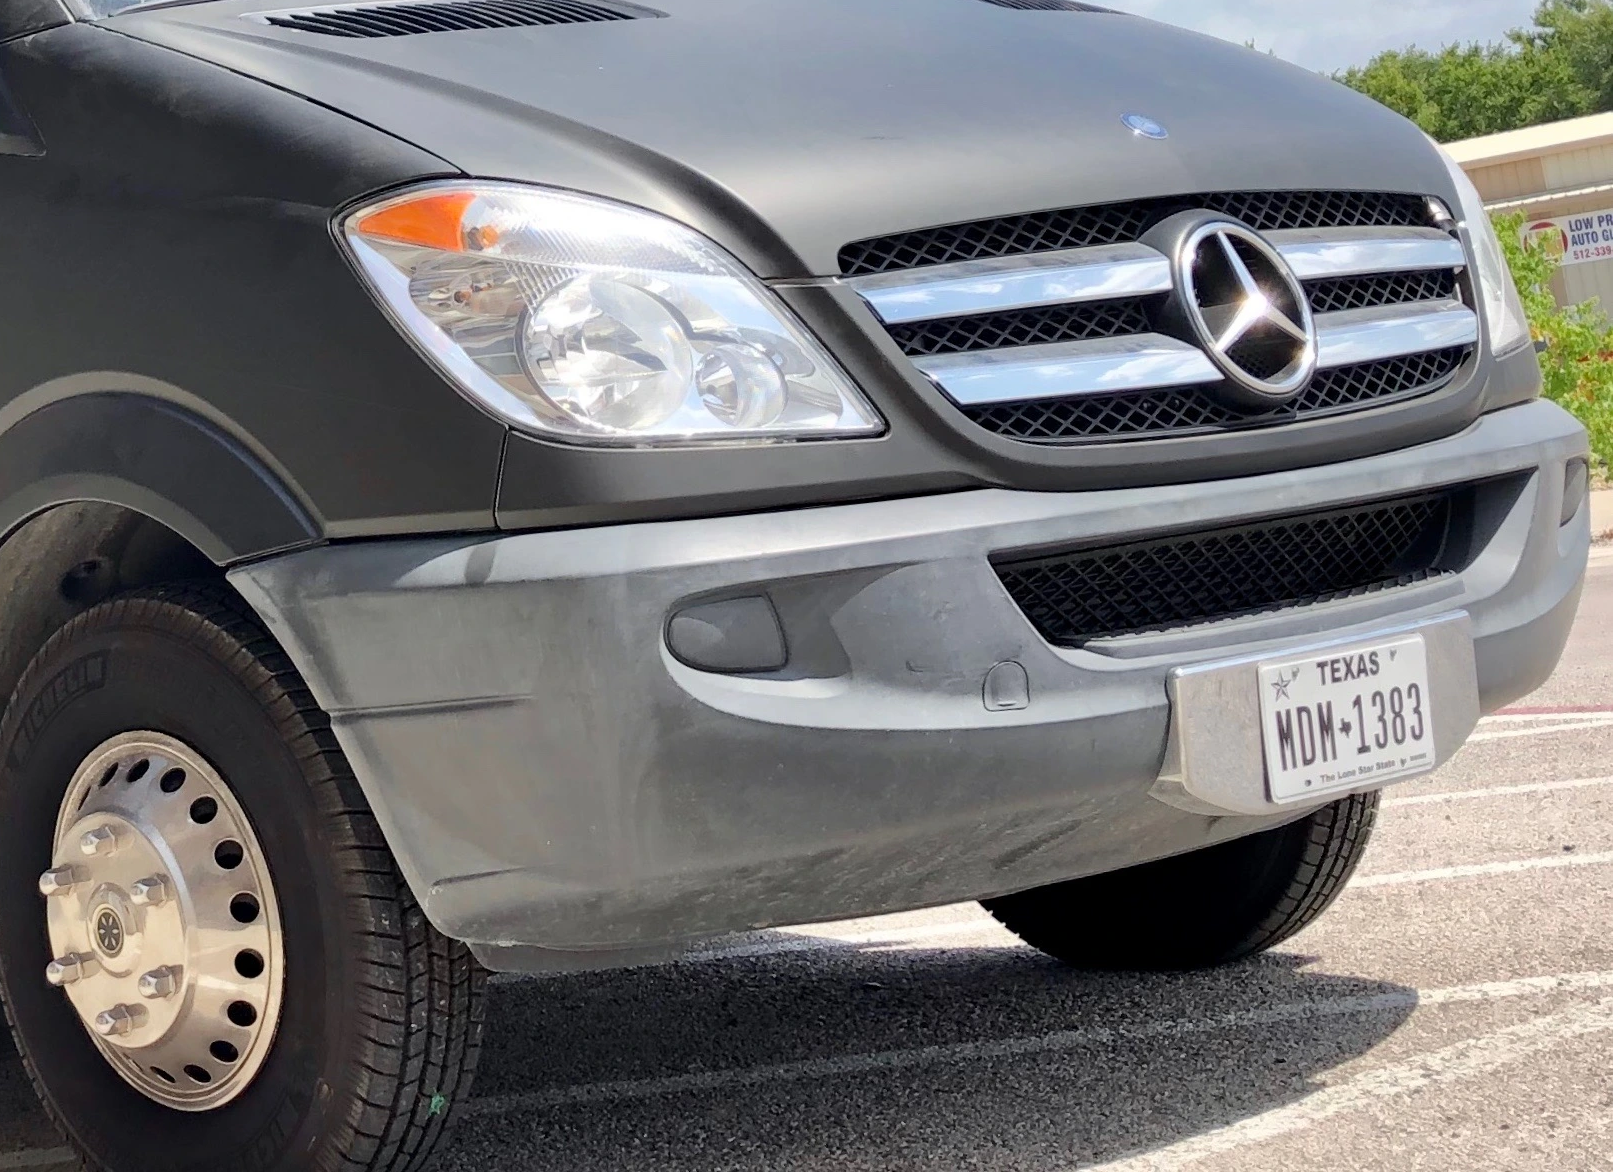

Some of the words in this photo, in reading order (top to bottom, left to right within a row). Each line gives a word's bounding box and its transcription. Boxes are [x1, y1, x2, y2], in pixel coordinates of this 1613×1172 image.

[1568, 216, 1594, 232] LOW
[1571, 231, 1599, 247] AUTO
[1316, 651, 1381, 686] TEXAS
[1320, 773, 1336, 784] The
[1337, 769, 1357, 779] Lone
[1358, 765, 1375, 775] Star
[1375, 759, 1396, 770] State
